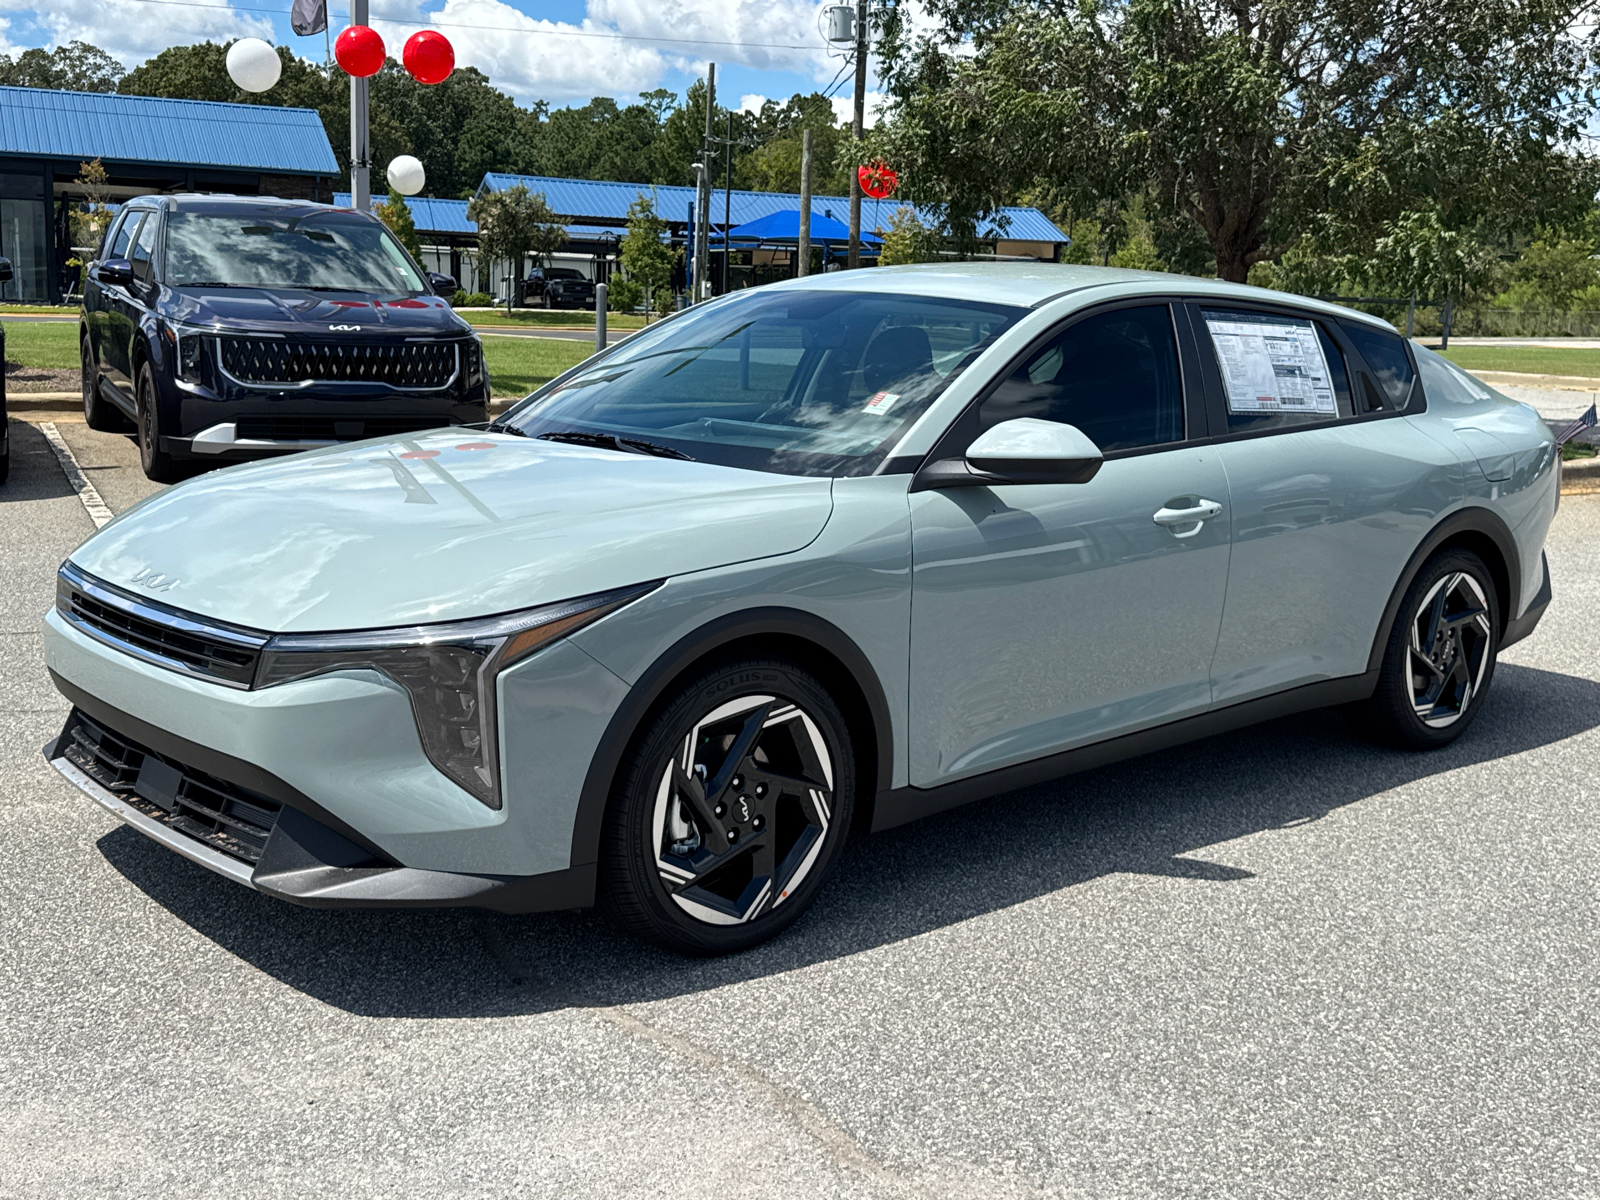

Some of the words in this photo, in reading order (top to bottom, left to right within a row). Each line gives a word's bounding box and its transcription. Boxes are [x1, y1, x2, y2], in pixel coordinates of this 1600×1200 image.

[329, 324, 361, 332] KIA
[705, 671, 761, 698] SOLUS
[636, 856, 653, 898] PREMIUM
